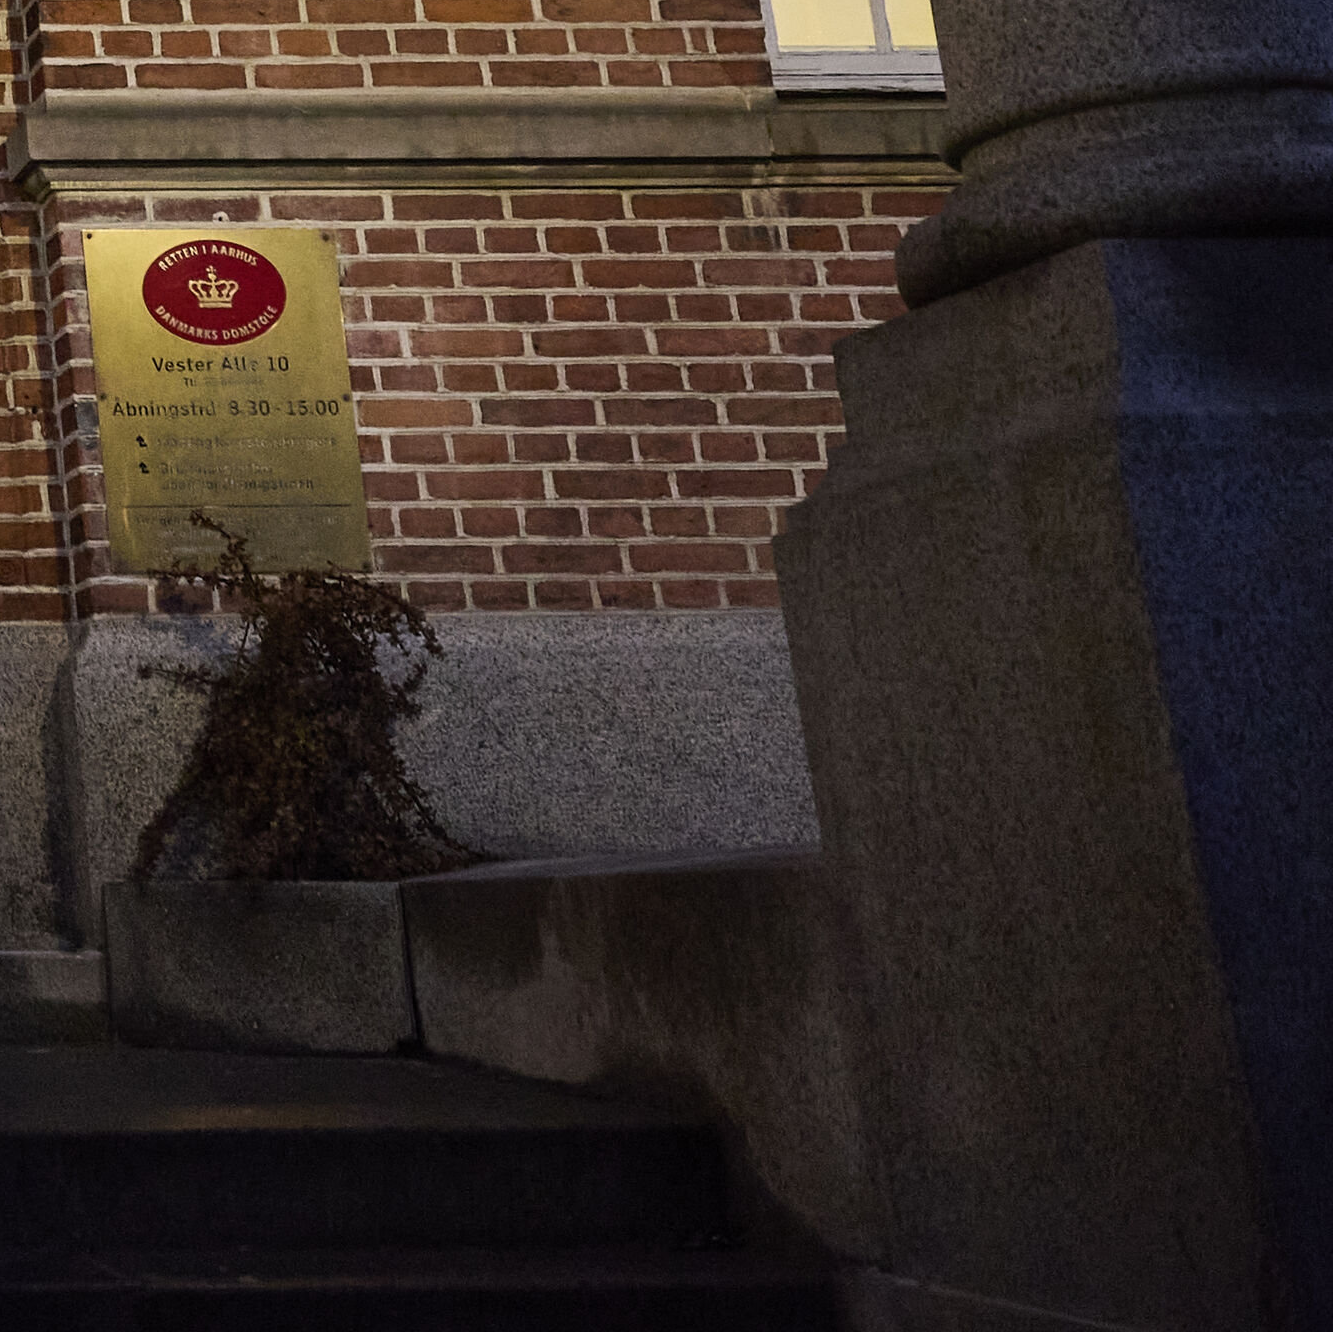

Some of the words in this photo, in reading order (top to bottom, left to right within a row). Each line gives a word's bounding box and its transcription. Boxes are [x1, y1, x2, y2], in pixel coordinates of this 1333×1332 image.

[158, 245, 199, 271] RETTEN
[202, 244, 207, 254] I
[211, 244, 258, 267] AARHUS
[156, 305, 218, 340] DANMARKS
[222, 305, 278, 340] DOMSTOLE
[151, 356, 214, 372] Vester
[267, 356, 289, 372] 10
[112, 397, 216, 418] Åbningstid
[286, 399, 339, 416] 15.00
